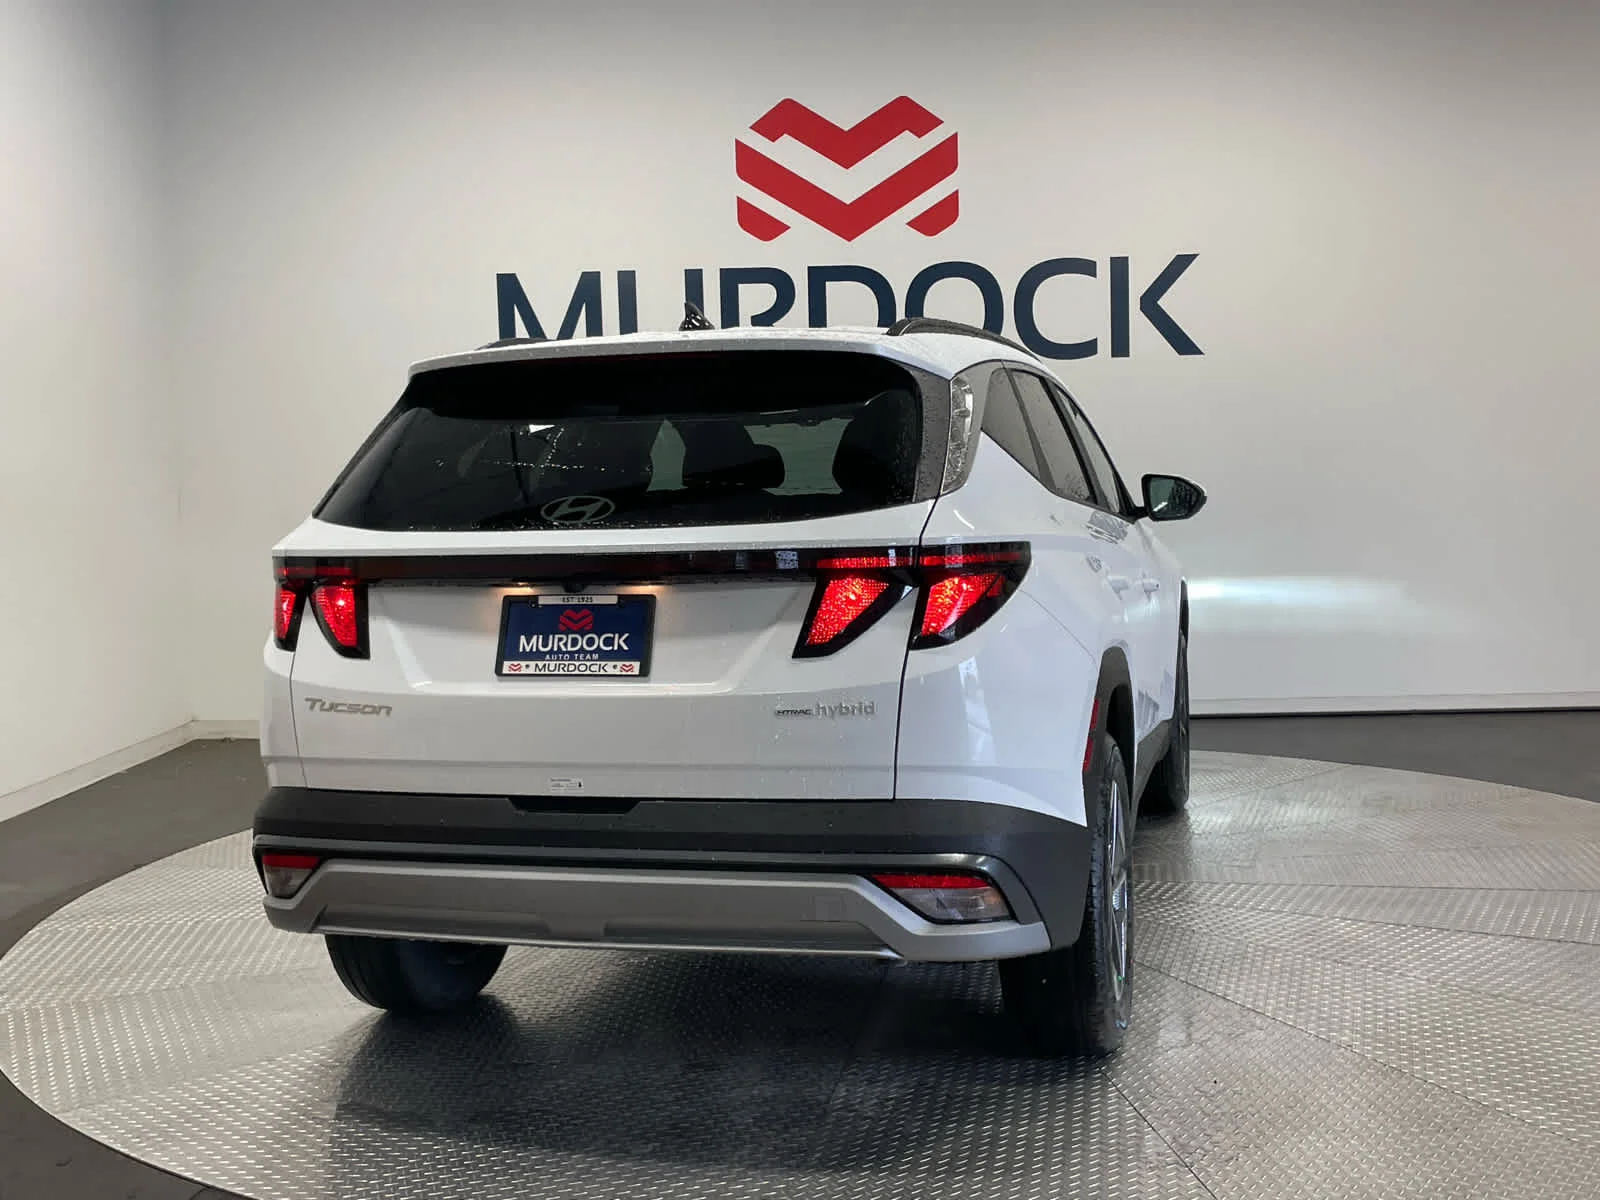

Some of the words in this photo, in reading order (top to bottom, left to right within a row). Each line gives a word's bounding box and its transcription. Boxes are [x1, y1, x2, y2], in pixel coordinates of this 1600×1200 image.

[519, 632, 630, 653] MURDOCK
[544, 653, 570, 661] AUTO
[574, 653, 599, 661] TEAM
[534, 662, 608, 673] MURDOCK
[816, 700, 876, 718] hybrid
